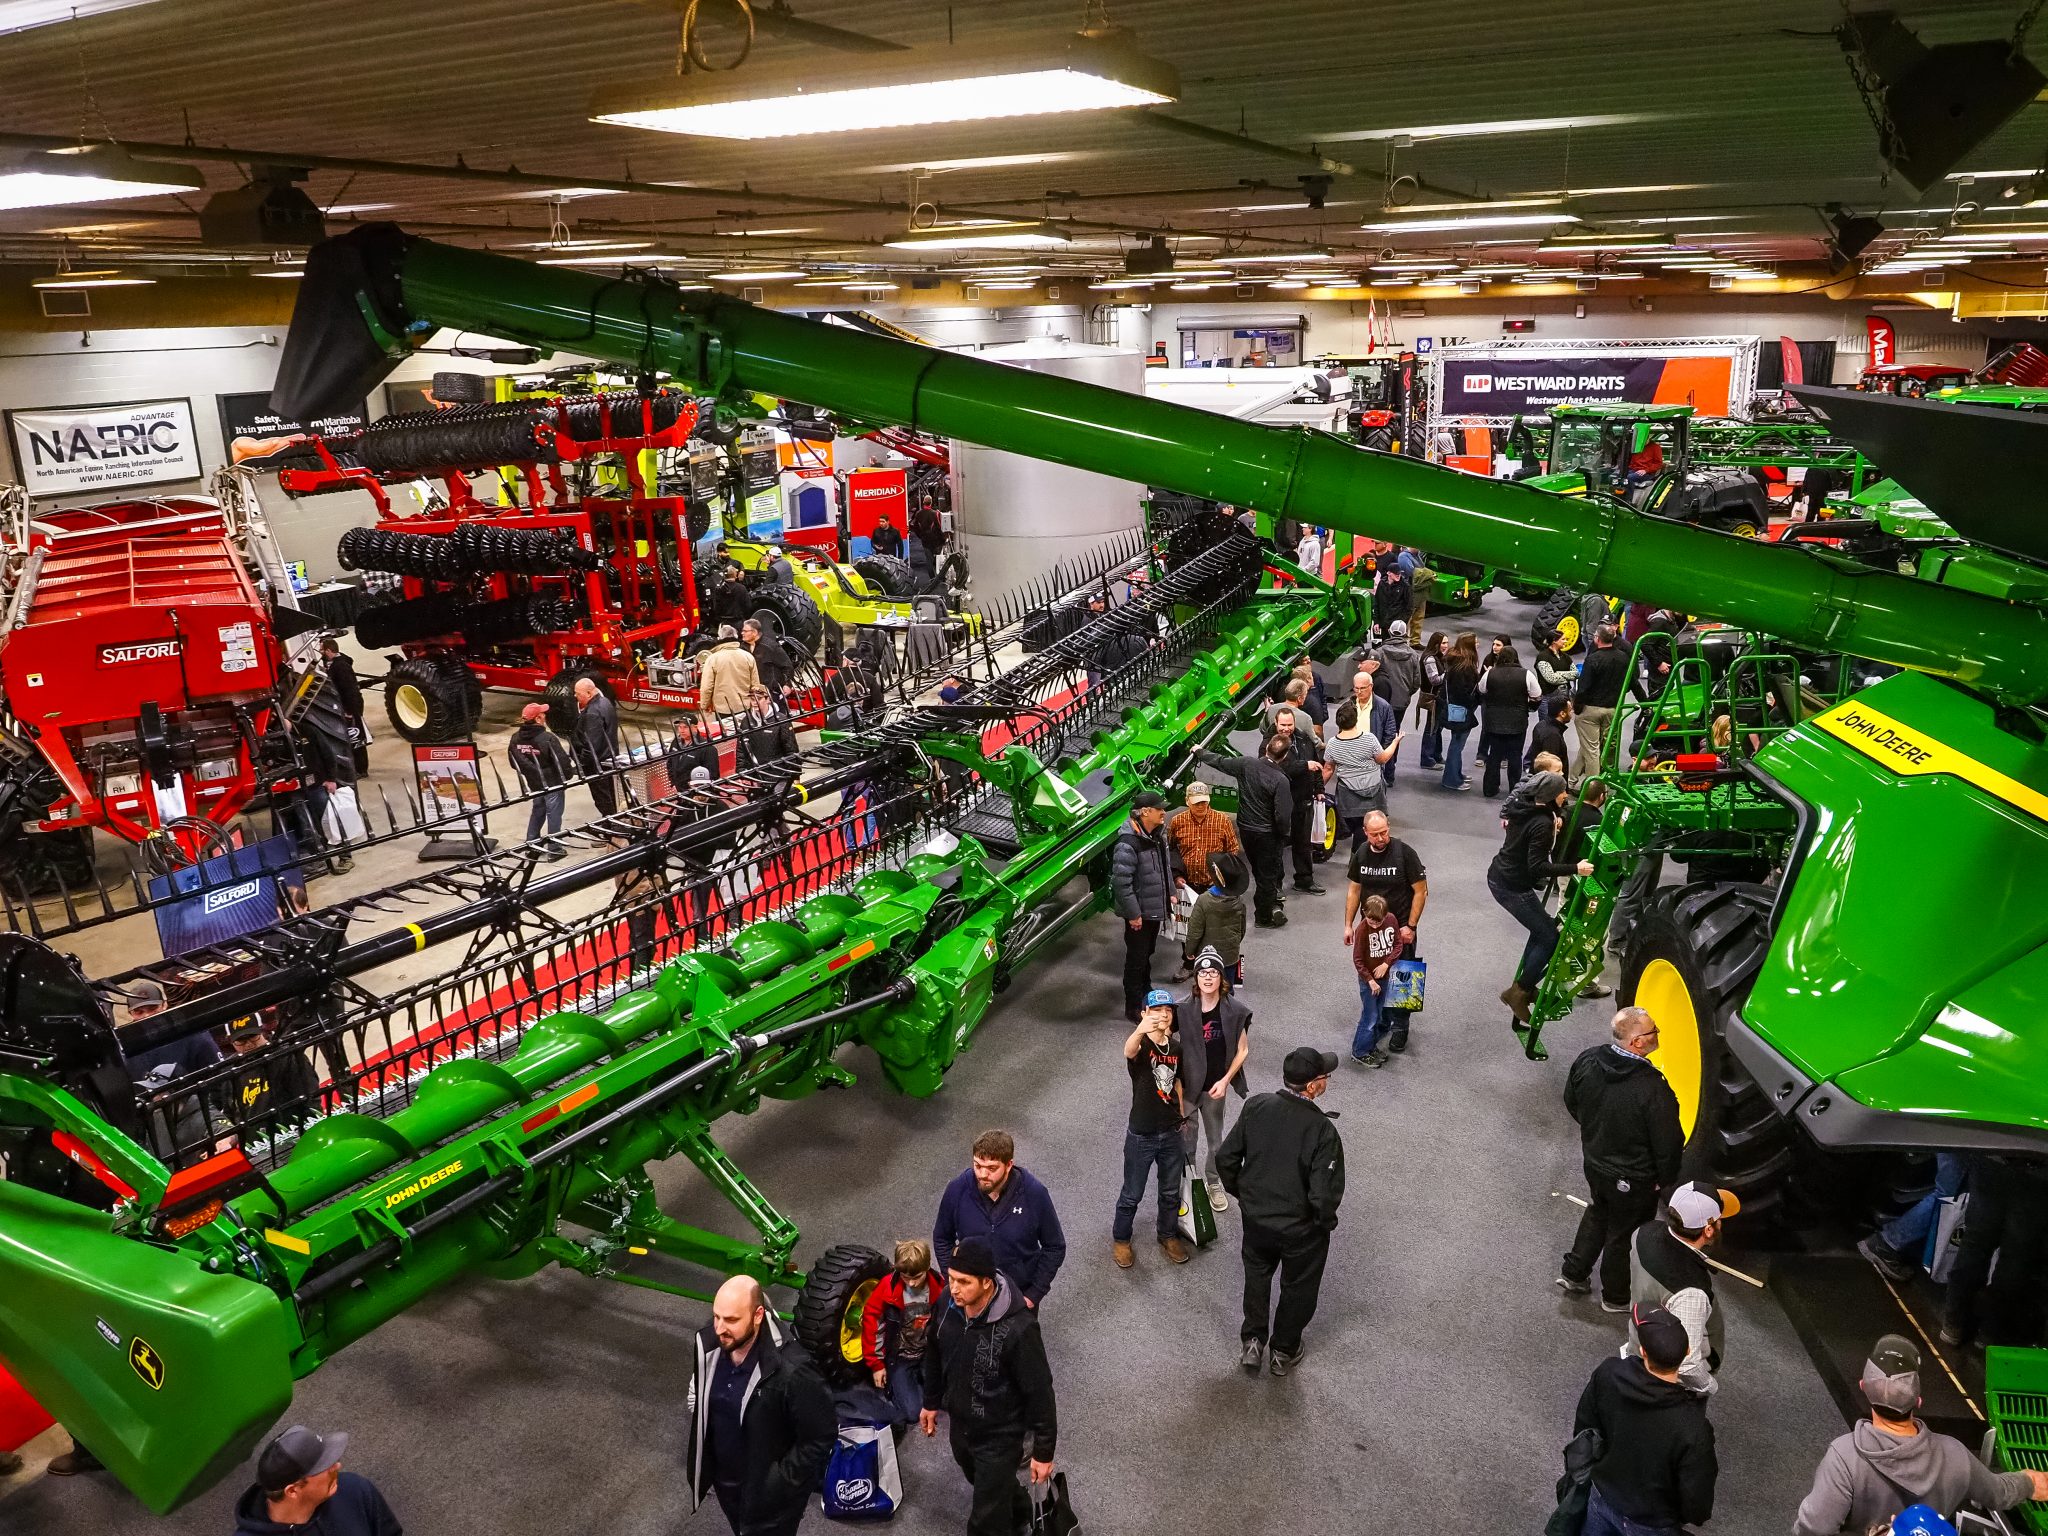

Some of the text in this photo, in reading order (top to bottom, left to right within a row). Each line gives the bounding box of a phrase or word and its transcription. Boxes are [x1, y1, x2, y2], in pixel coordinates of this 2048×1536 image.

[1494, 376, 1625, 391] WESTWARD PARTS
[1526, 396, 1566, 405] Westward
[1567, 396, 1582, 404] has
[131, 411, 175, 421] ADVANTAGE
[254, 415, 282, 425] Safety.
[324, 416, 361, 426] Manitoba
[235, 426, 248, 435] It's
[257, 425, 276, 434] your
[277, 421, 301, 431] hands.
[324, 424, 350, 434] Hydro
[29, 420, 179, 466] NAERIC
[36, 455, 184, 477] North American Equine Ranching Information Council
[79, 468, 154, 483] WWW.NAERIC.ORG
[854, 486, 897, 498] MERIDIAN
[102, 641, 183, 665] SALFORD
[662, 694, 681, 703] HALO
[681, 696, 694, 704] VRT
[1835, 711, 1933, 766] JOHN DEERE
[209, 881, 256, 908] SALFORD
[1369, 926, 1395, 951] BIG
[385, 1160, 464, 1209] JOHN DEERE
